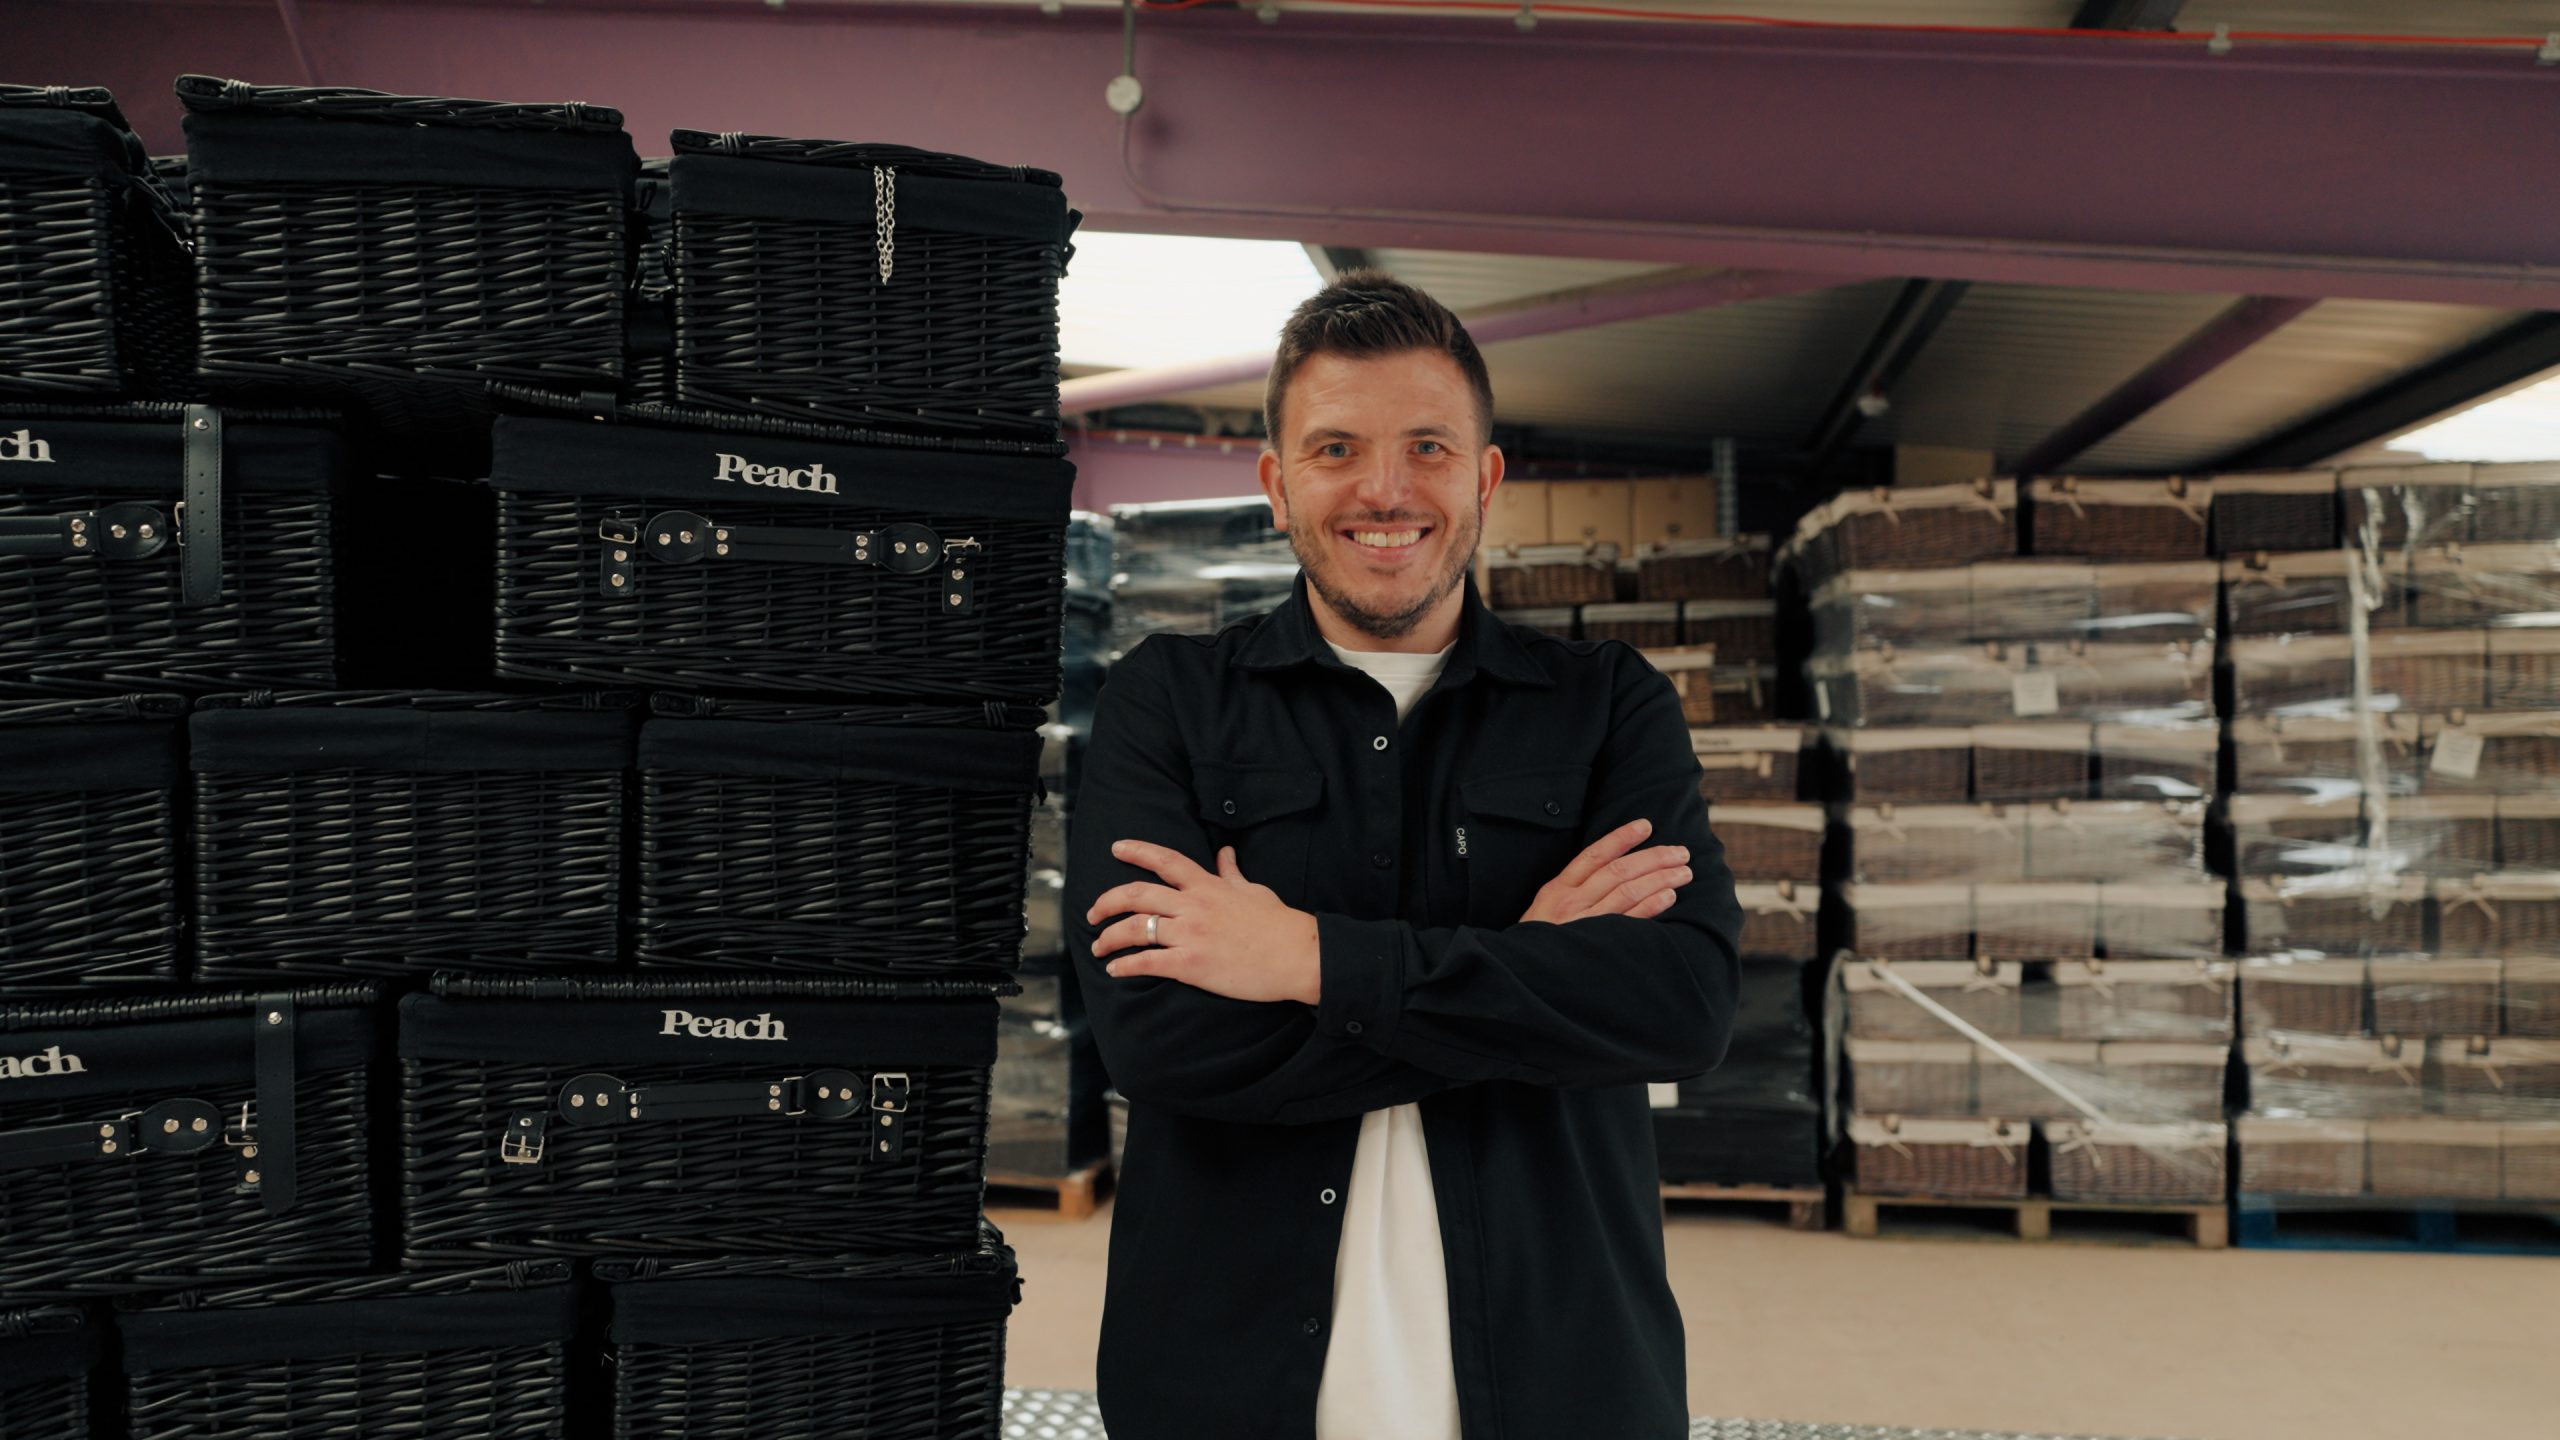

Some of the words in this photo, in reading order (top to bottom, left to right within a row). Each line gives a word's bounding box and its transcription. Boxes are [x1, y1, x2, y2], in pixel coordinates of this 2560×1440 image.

[713, 453, 840, 495] Peach
[1456, 827, 1467, 855] CAPO
[659, 1009, 788, 1040] Peach
[0, 1045, 88, 1079] ach
